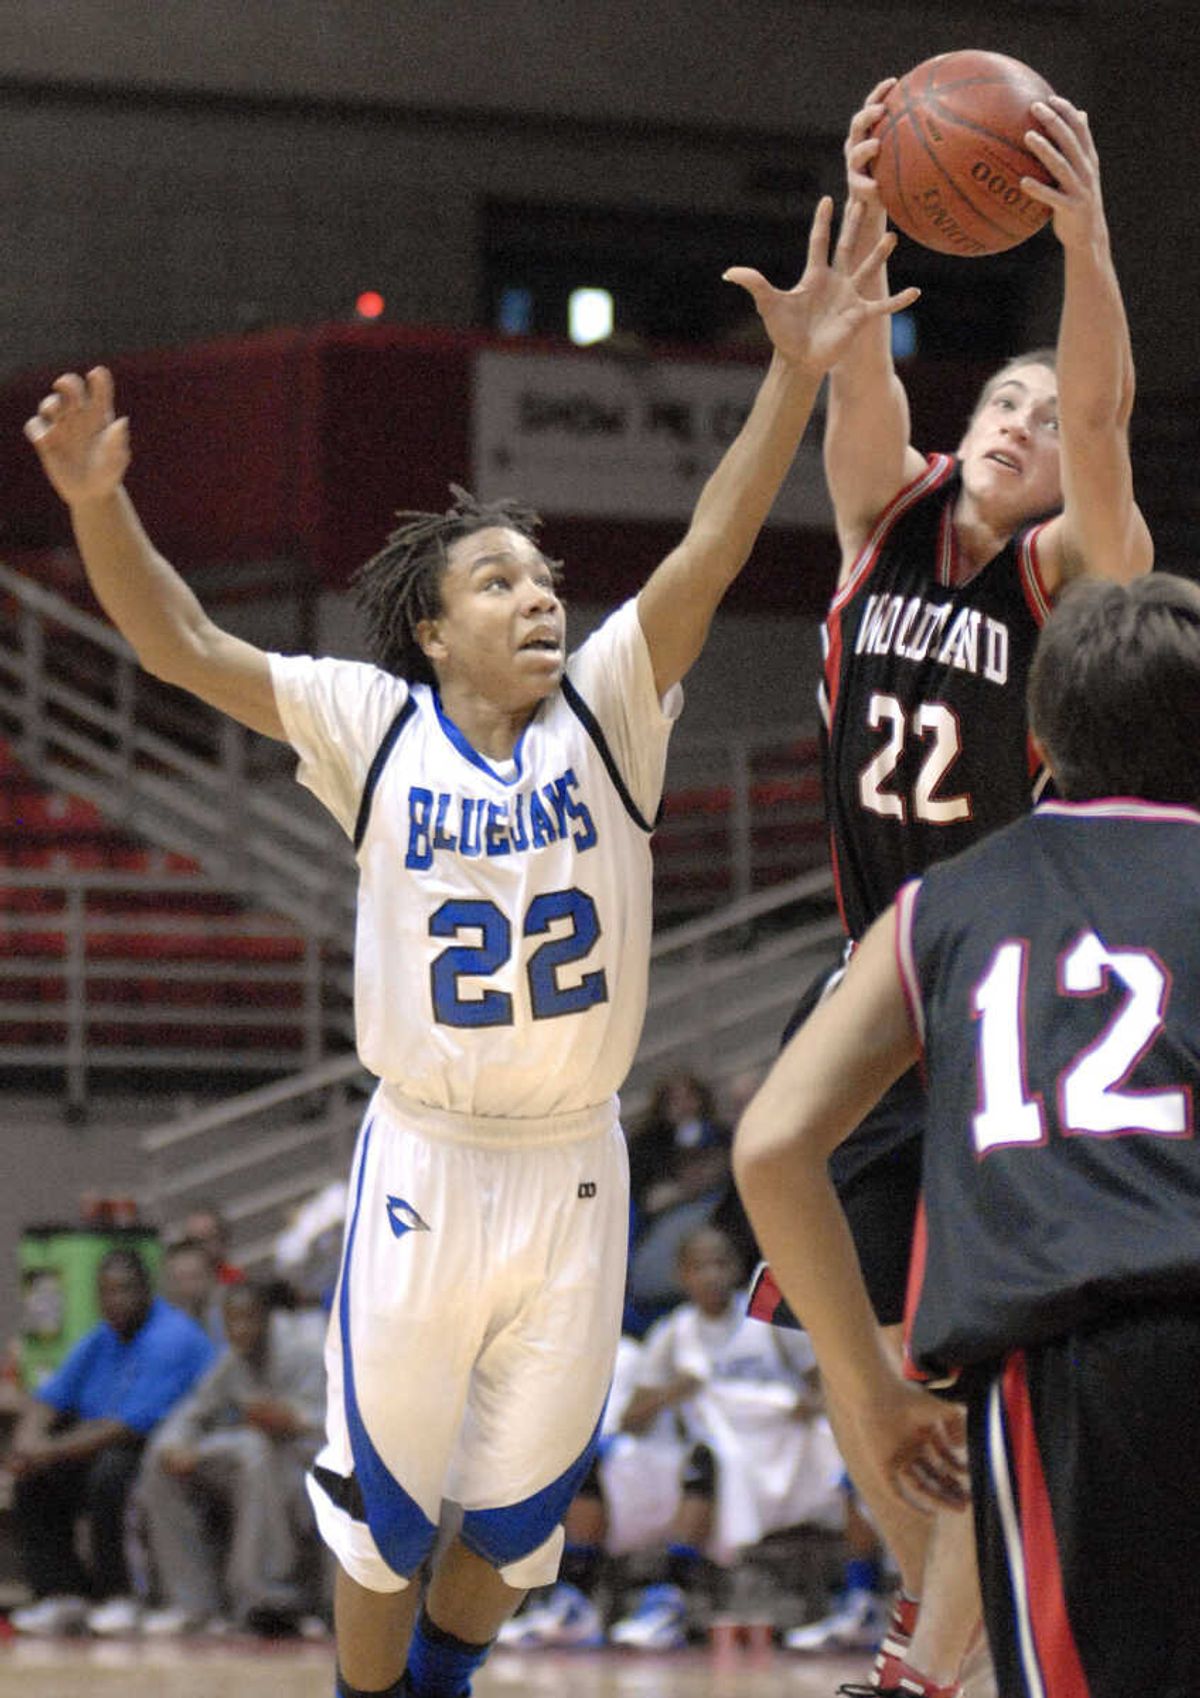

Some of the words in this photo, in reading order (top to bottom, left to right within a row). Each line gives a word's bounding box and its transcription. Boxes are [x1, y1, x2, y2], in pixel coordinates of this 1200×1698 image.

[404, 767, 599, 871] BLUEJAYS
[859, 690, 974, 825] 22
[428, 886, 610, 1029] 22
[969, 927, 1194, 1162] 12
